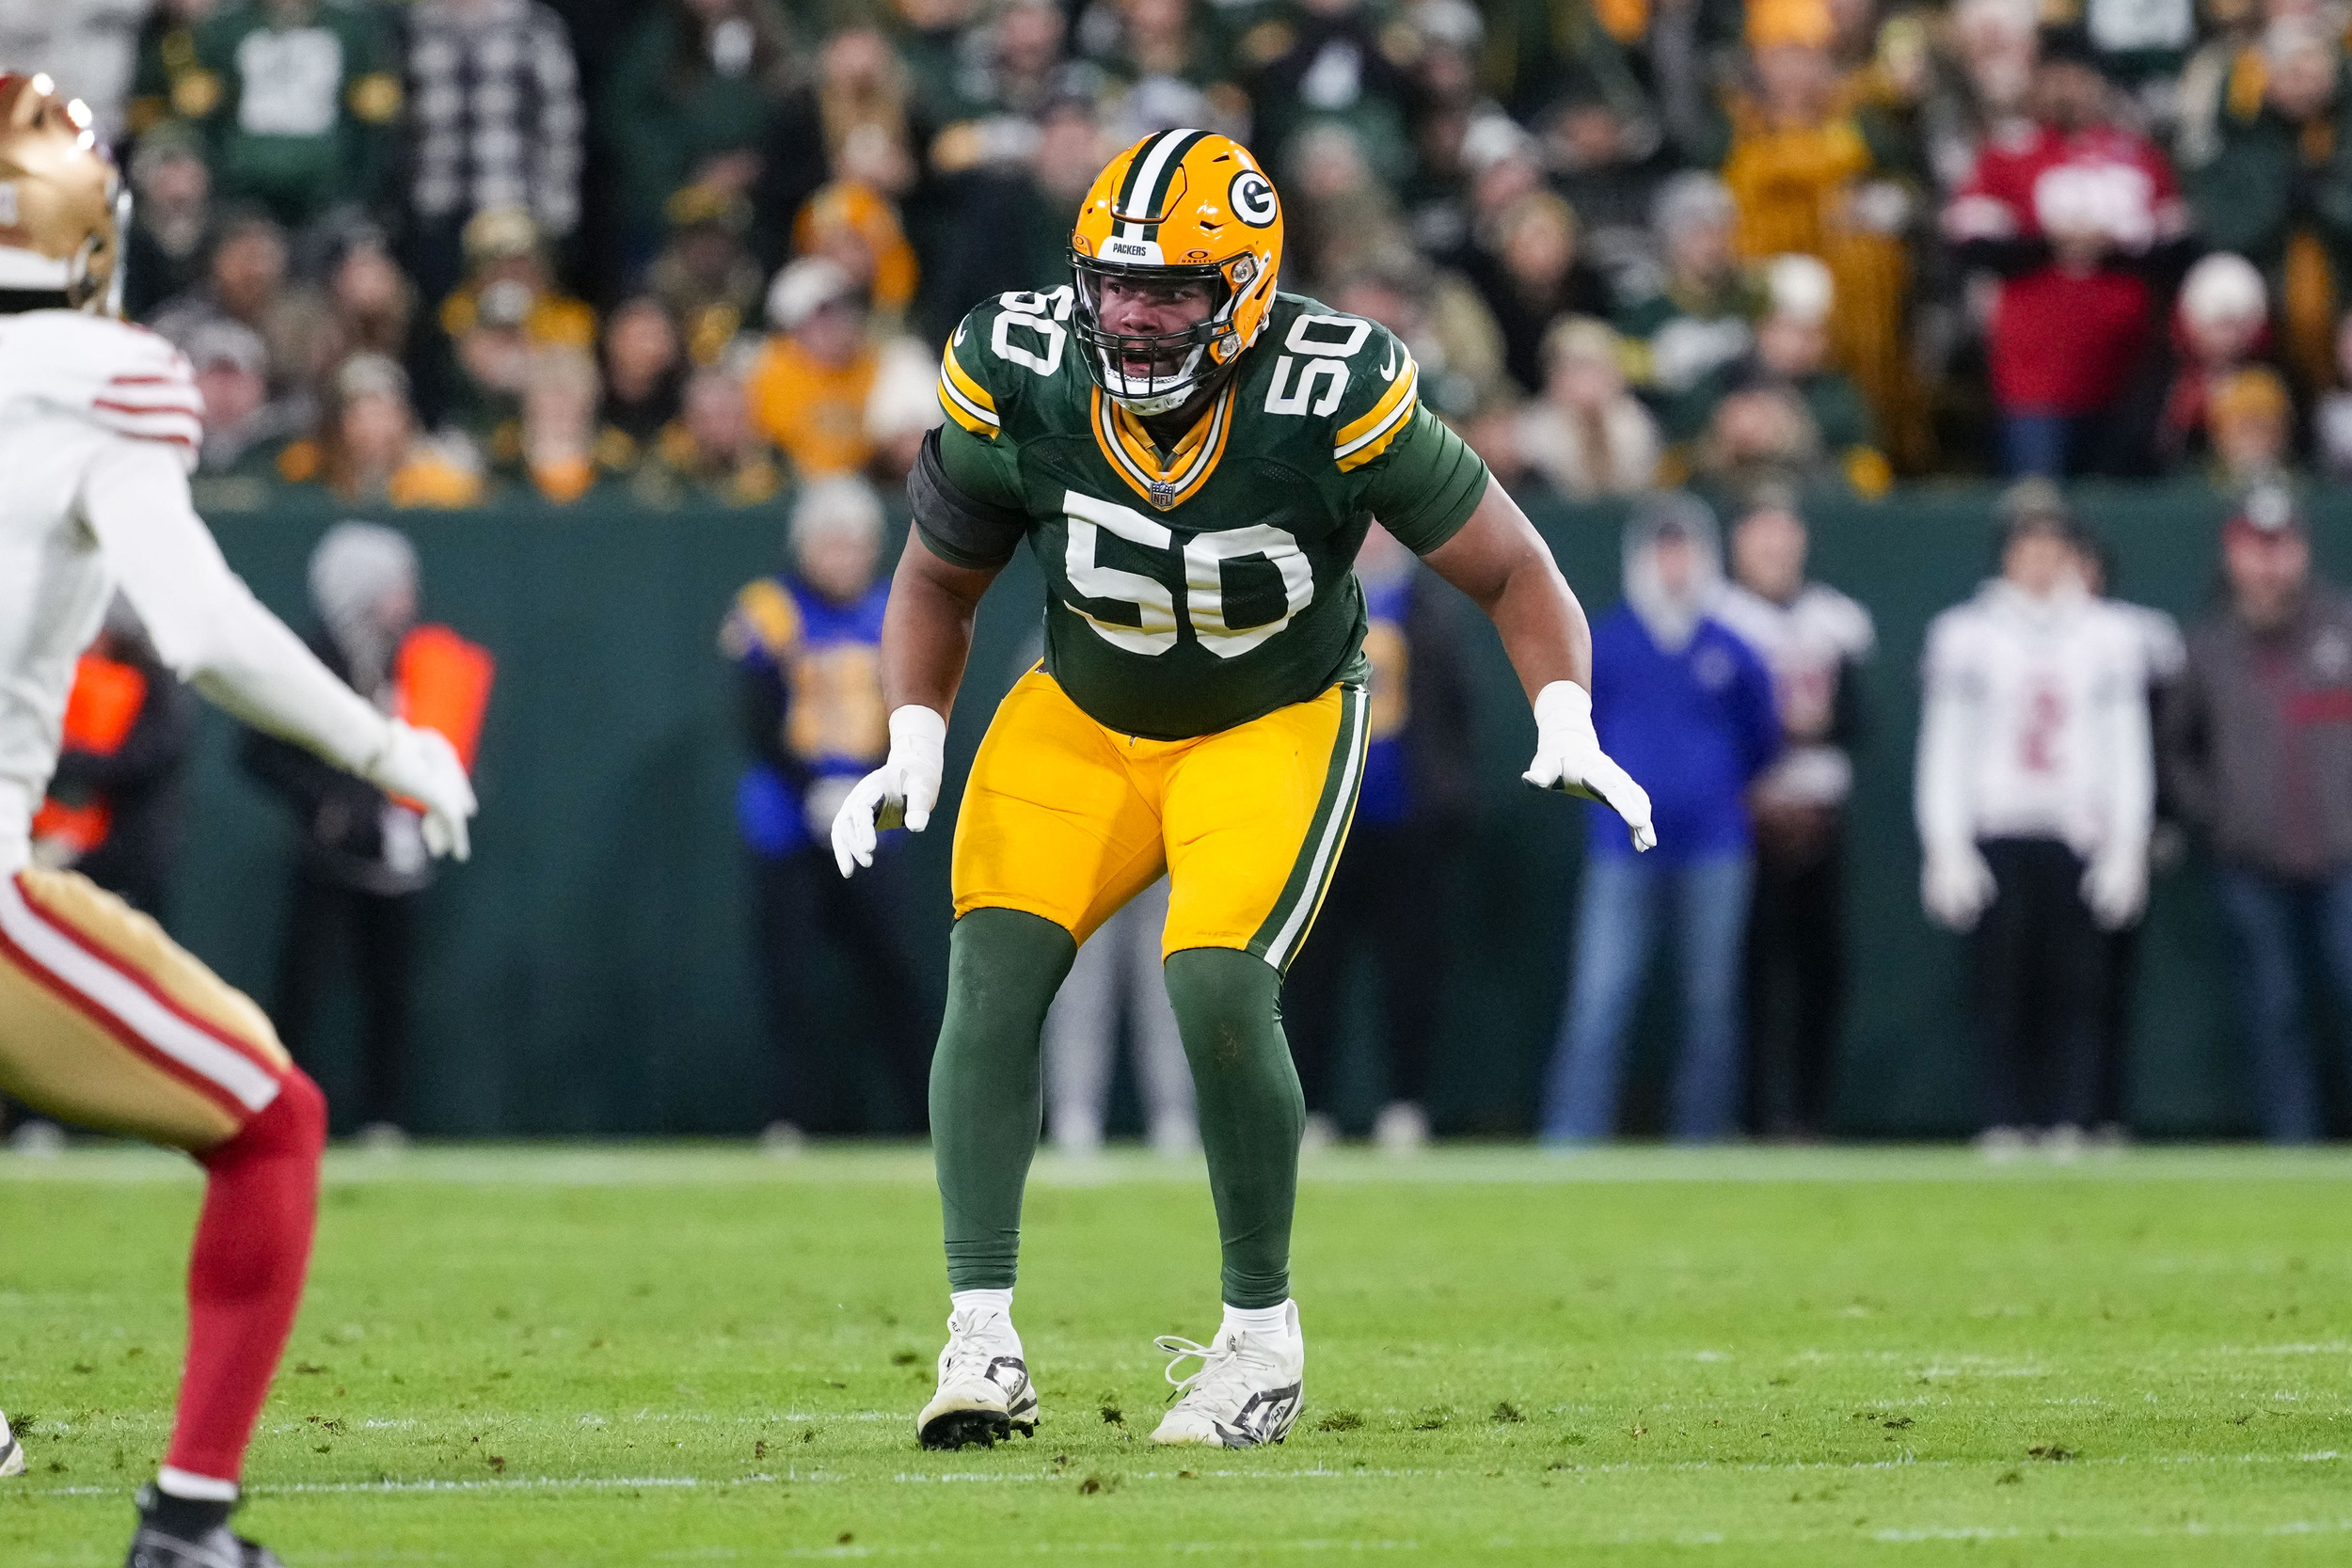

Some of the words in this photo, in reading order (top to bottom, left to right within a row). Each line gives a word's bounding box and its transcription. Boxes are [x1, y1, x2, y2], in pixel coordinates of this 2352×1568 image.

[1228, 169, 1277, 229] G
[1112, 243, 1147, 257] PACKERS
[1263, 314, 1373, 418] 50
[1153, 494, 1170, 504] NFL
[1062, 489, 1314, 658] 50
